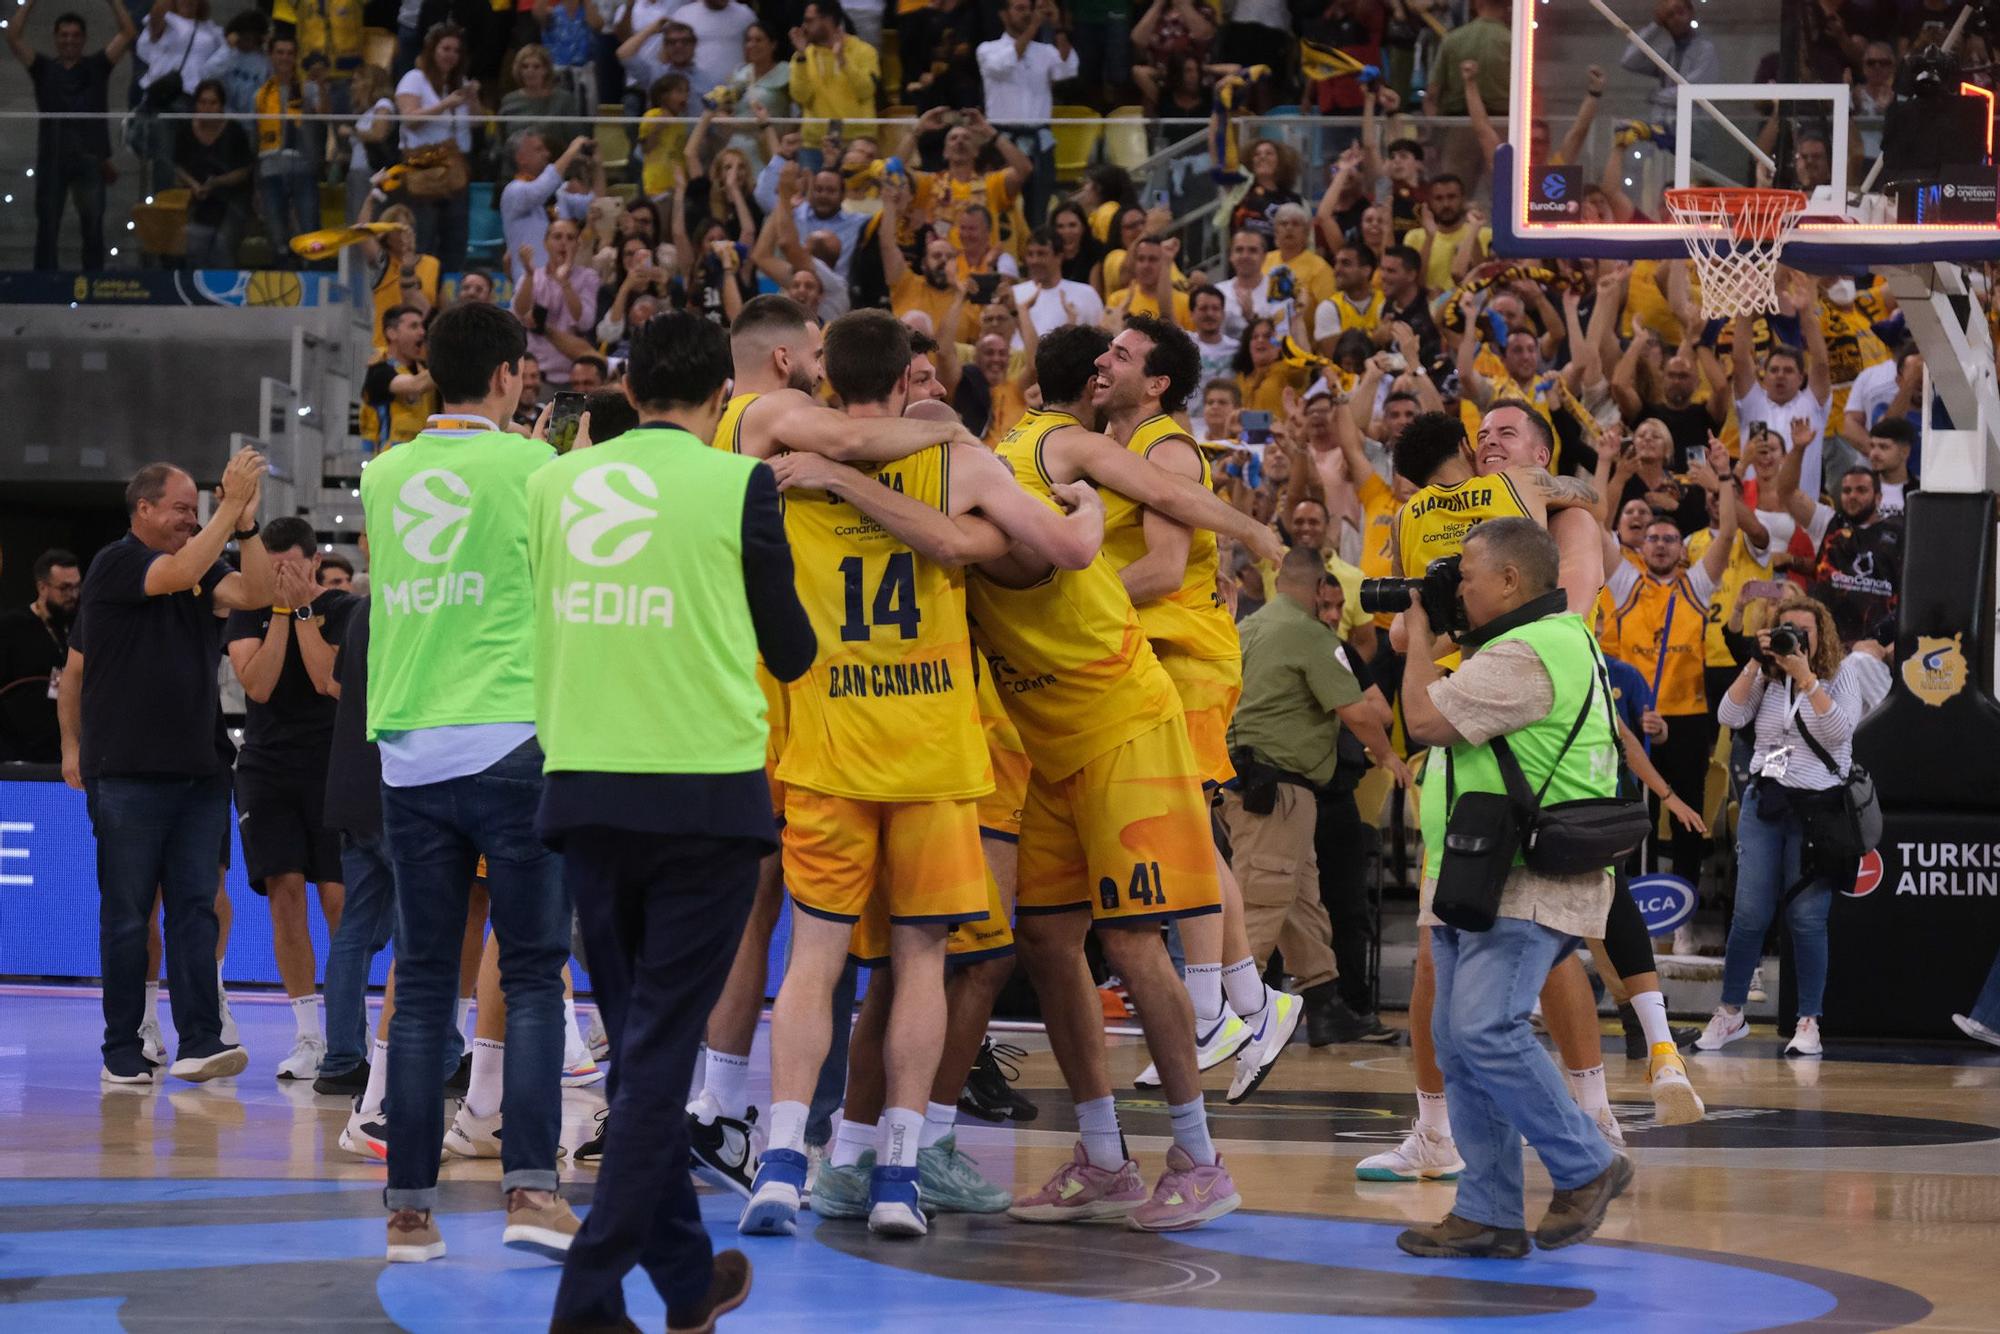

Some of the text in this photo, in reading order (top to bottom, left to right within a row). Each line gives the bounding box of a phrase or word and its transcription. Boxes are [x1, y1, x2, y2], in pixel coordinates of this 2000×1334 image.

[1956, 189, 1996, 198] oneteam
[1530, 201, 1566, 212] EuroCup
[834, 523, 888, 536] Canaria
[838, 551, 921, 642] 14
[871, 658, 954, 697] CANARIA
[1129, 861, 1166, 906] 41
[1634, 896, 1677, 914] LCA
